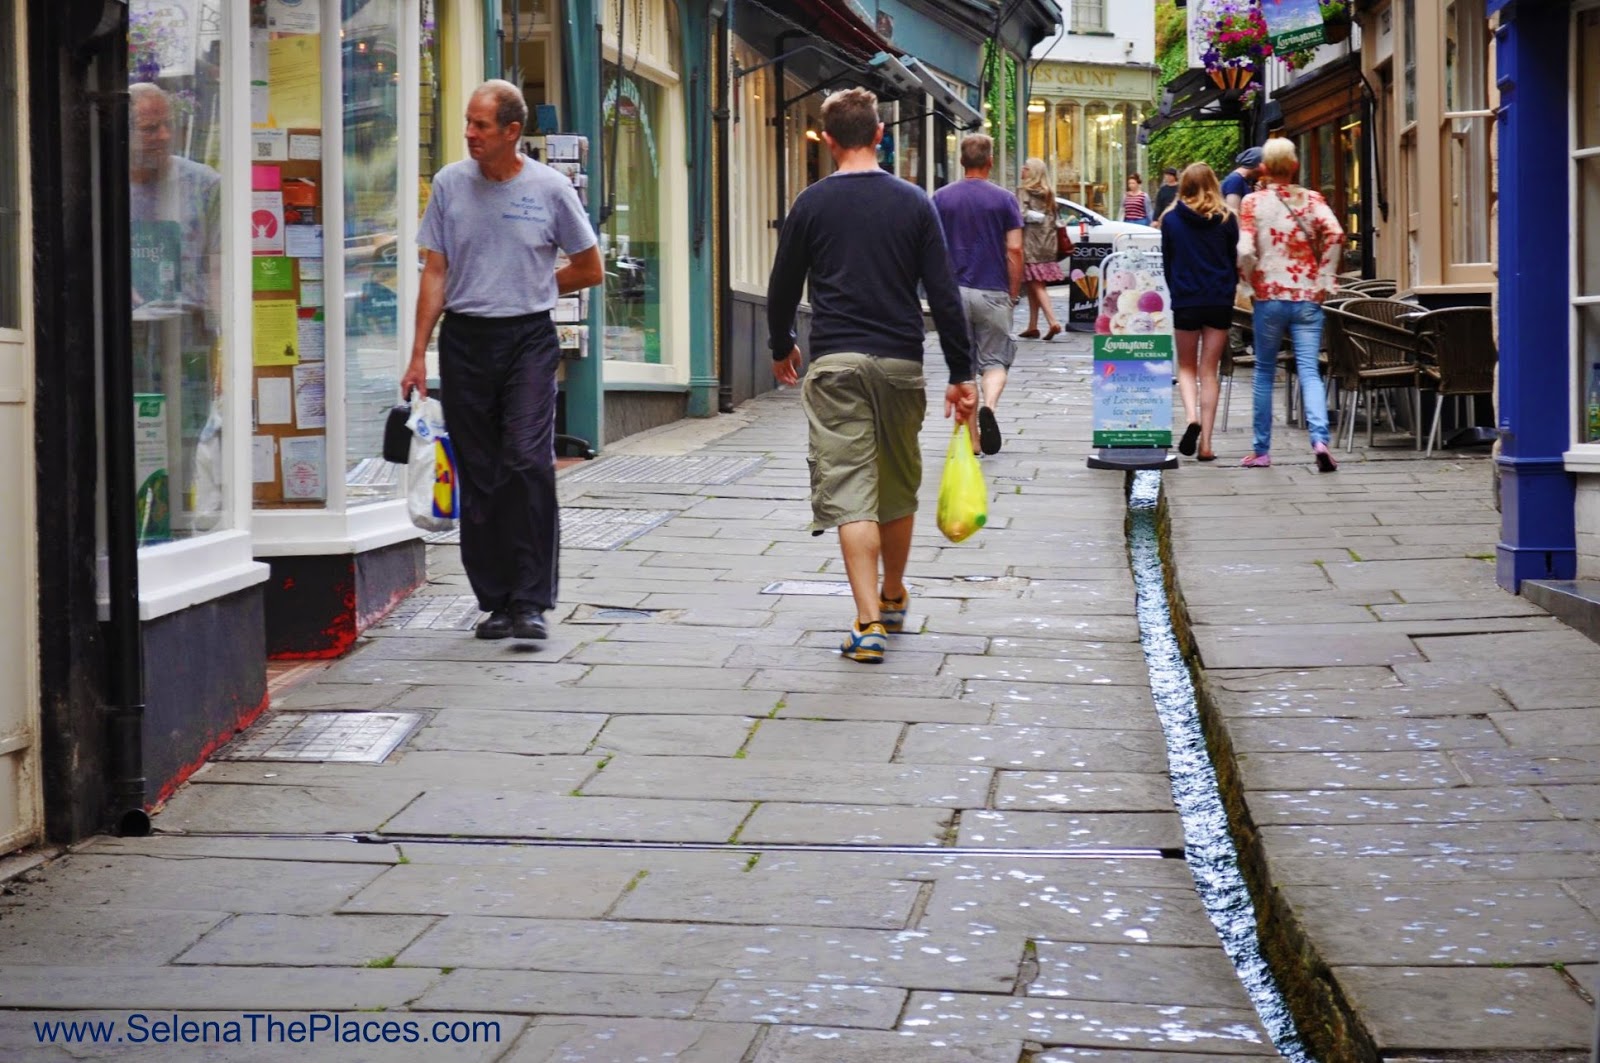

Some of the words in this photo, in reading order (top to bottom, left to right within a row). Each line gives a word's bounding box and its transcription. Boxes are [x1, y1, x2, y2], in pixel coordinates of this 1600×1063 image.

[1275, 28, 1322, 49] Lovington's
[1057, 67, 1117, 86] GAUNT
[1101, 336, 1155, 354] Lovington's
[1112, 373, 1136, 382] You'll
[1138, 373, 1157, 382] love
[1116, 385, 1128, 393] the
[1102, 397, 1111, 406] of
[1113, 396, 1164, 406] Lovington's
